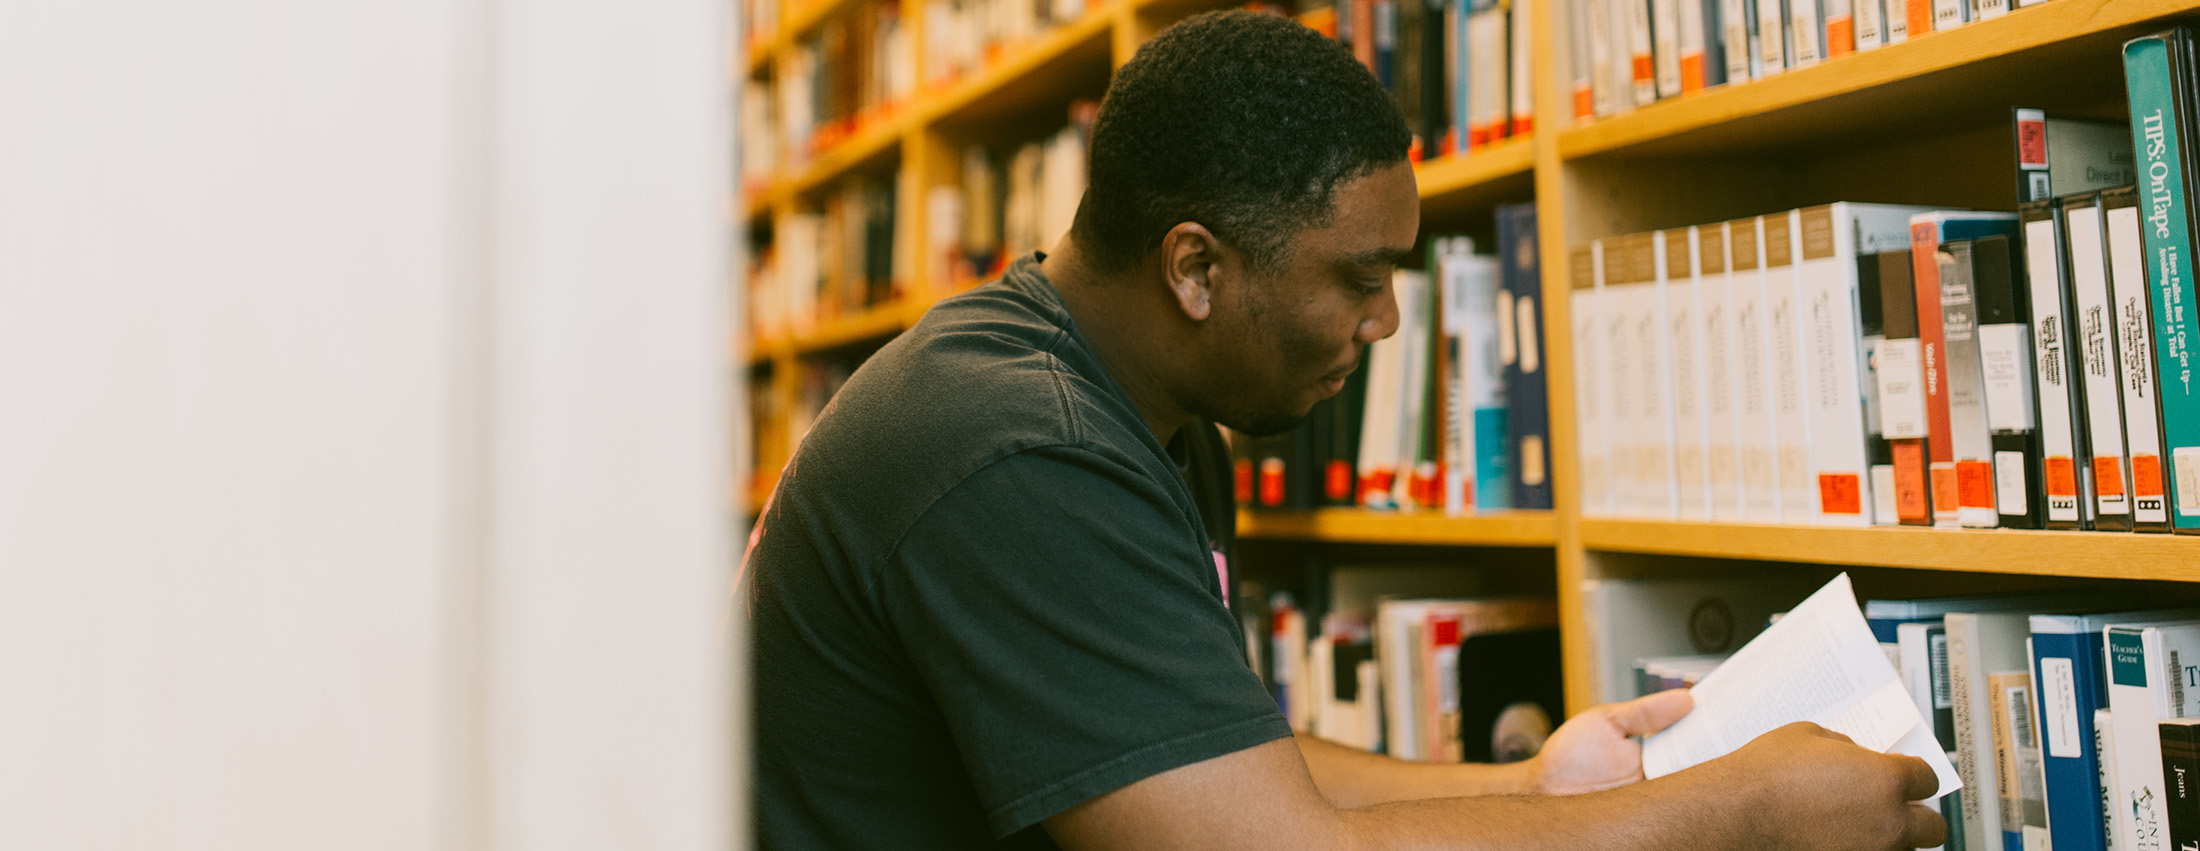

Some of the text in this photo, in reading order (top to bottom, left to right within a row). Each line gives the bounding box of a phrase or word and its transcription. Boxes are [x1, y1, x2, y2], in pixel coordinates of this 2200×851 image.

[2168, 253, 2177, 275] Have
[2171, 277, 2181, 304] Fallen
[2159, 247, 2178, 358] Avoiding Disaster at Trial
[2174, 305, 2183, 322] But
[2177, 330, 2186, 349] Can
[2180, 351, 2188, 367] Get
[2174, 764, 2186, 798] Jeans
